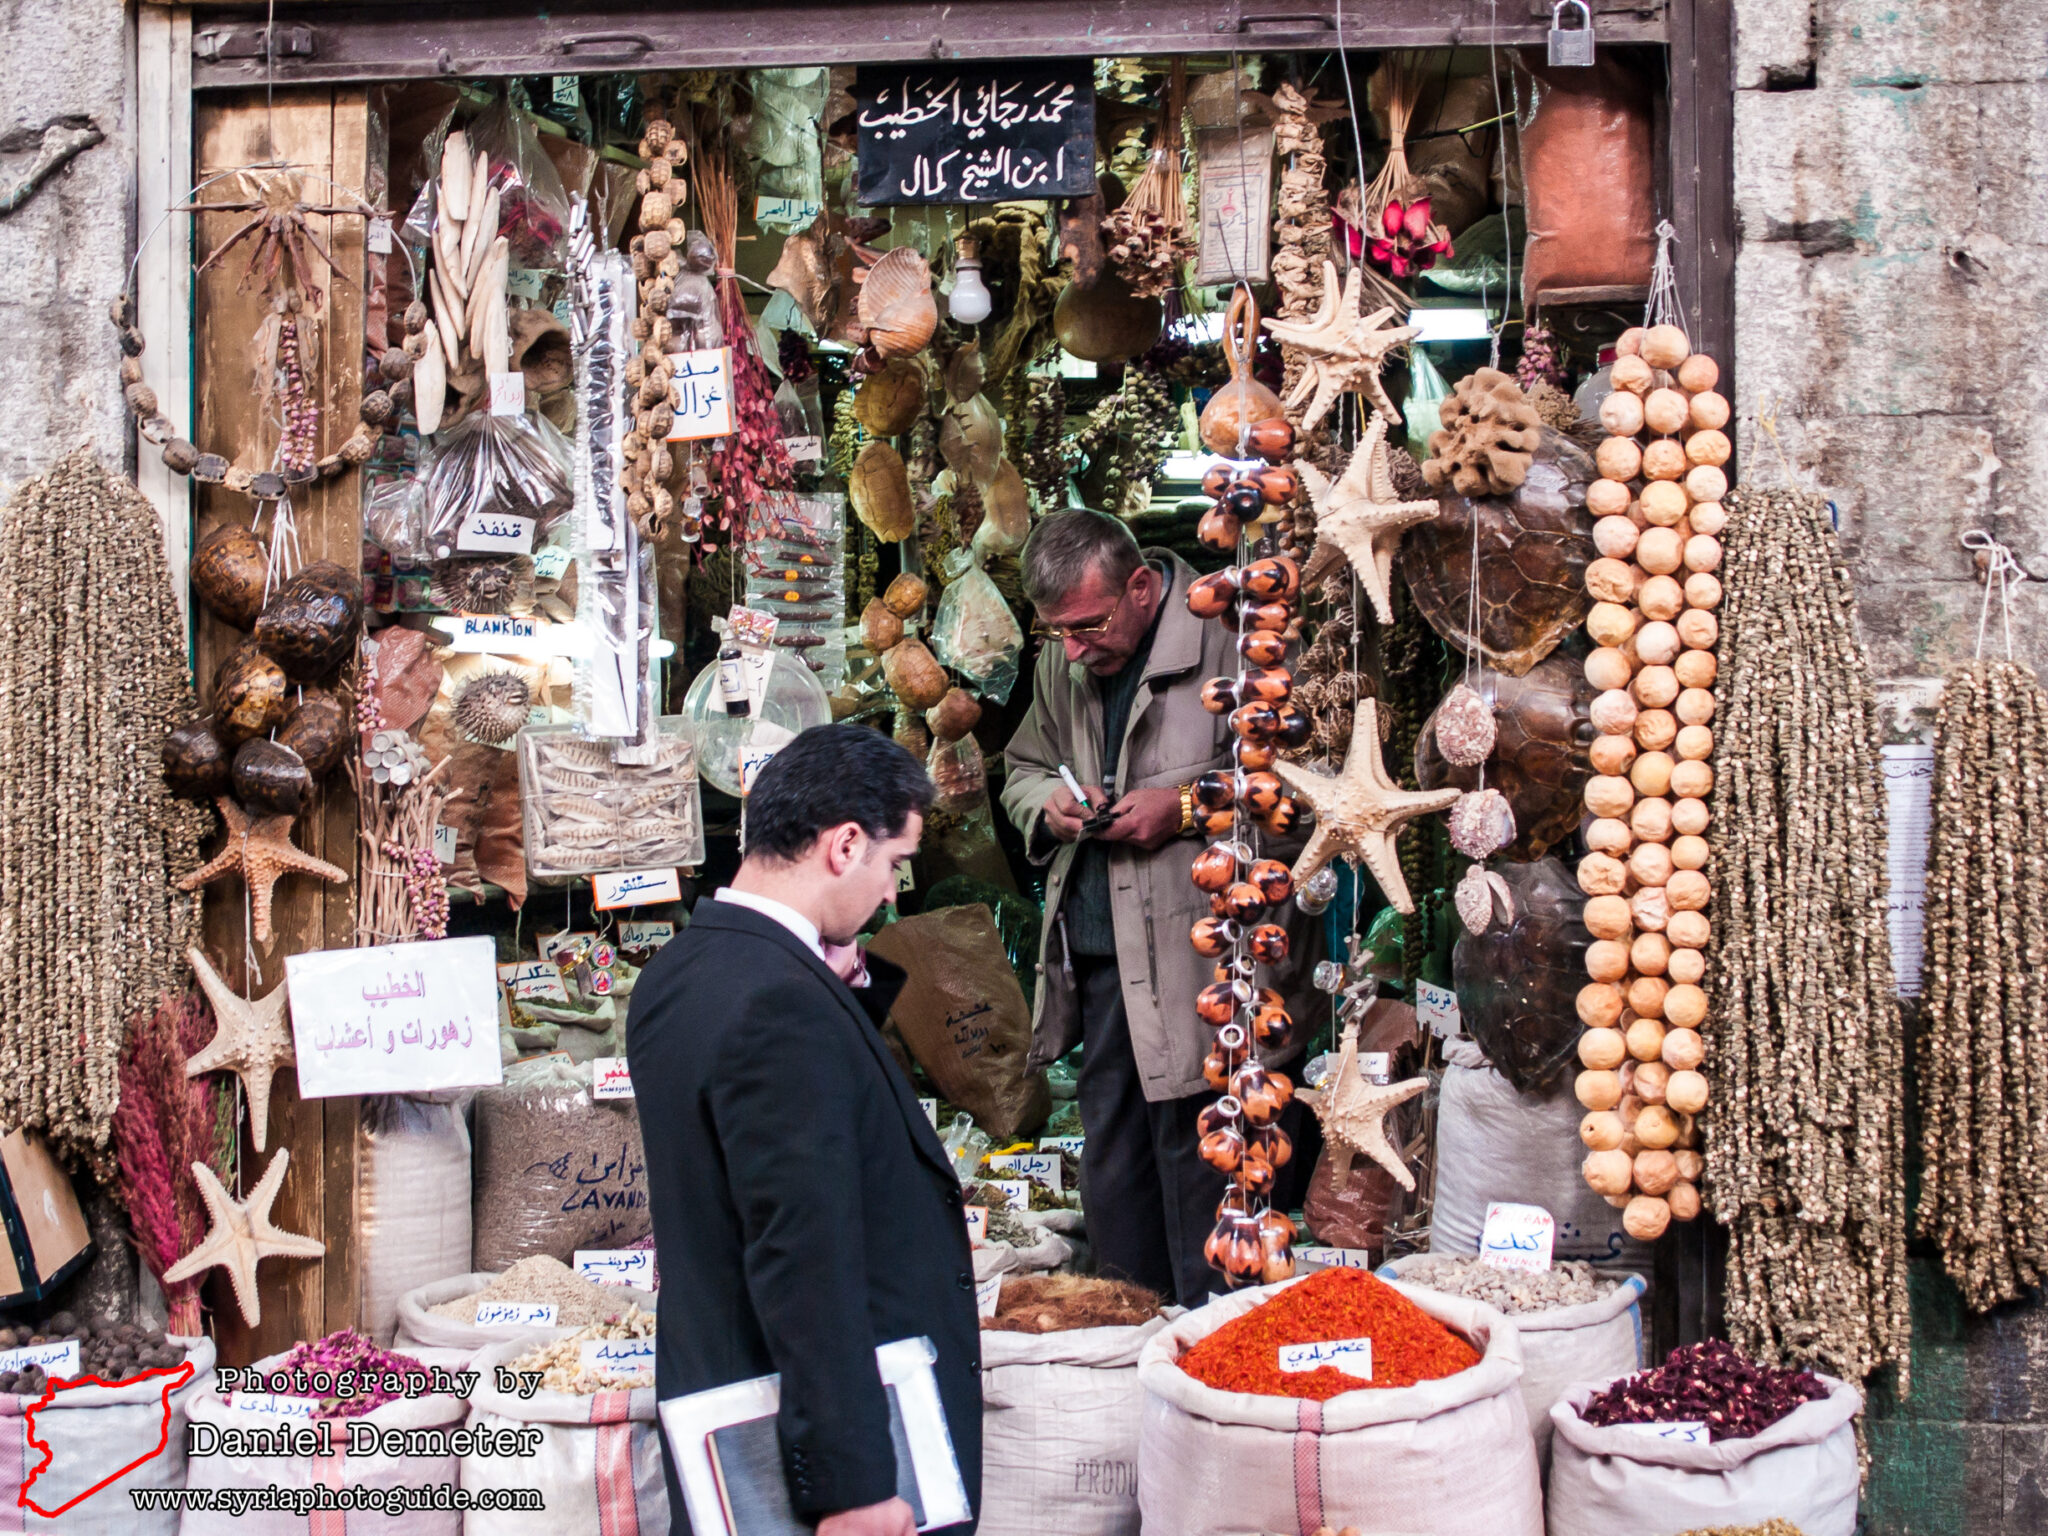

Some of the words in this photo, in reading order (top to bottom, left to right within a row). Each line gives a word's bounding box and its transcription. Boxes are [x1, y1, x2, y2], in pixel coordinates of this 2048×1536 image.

[472, 519, 522, 538] قنفذ
[361, 970, 426, 1009] الخطيب
[383, 1029, 396, 1054] و
[401, 1015, 473, 1051] زهورات
[522, 1306, 551, 1325] زهر
